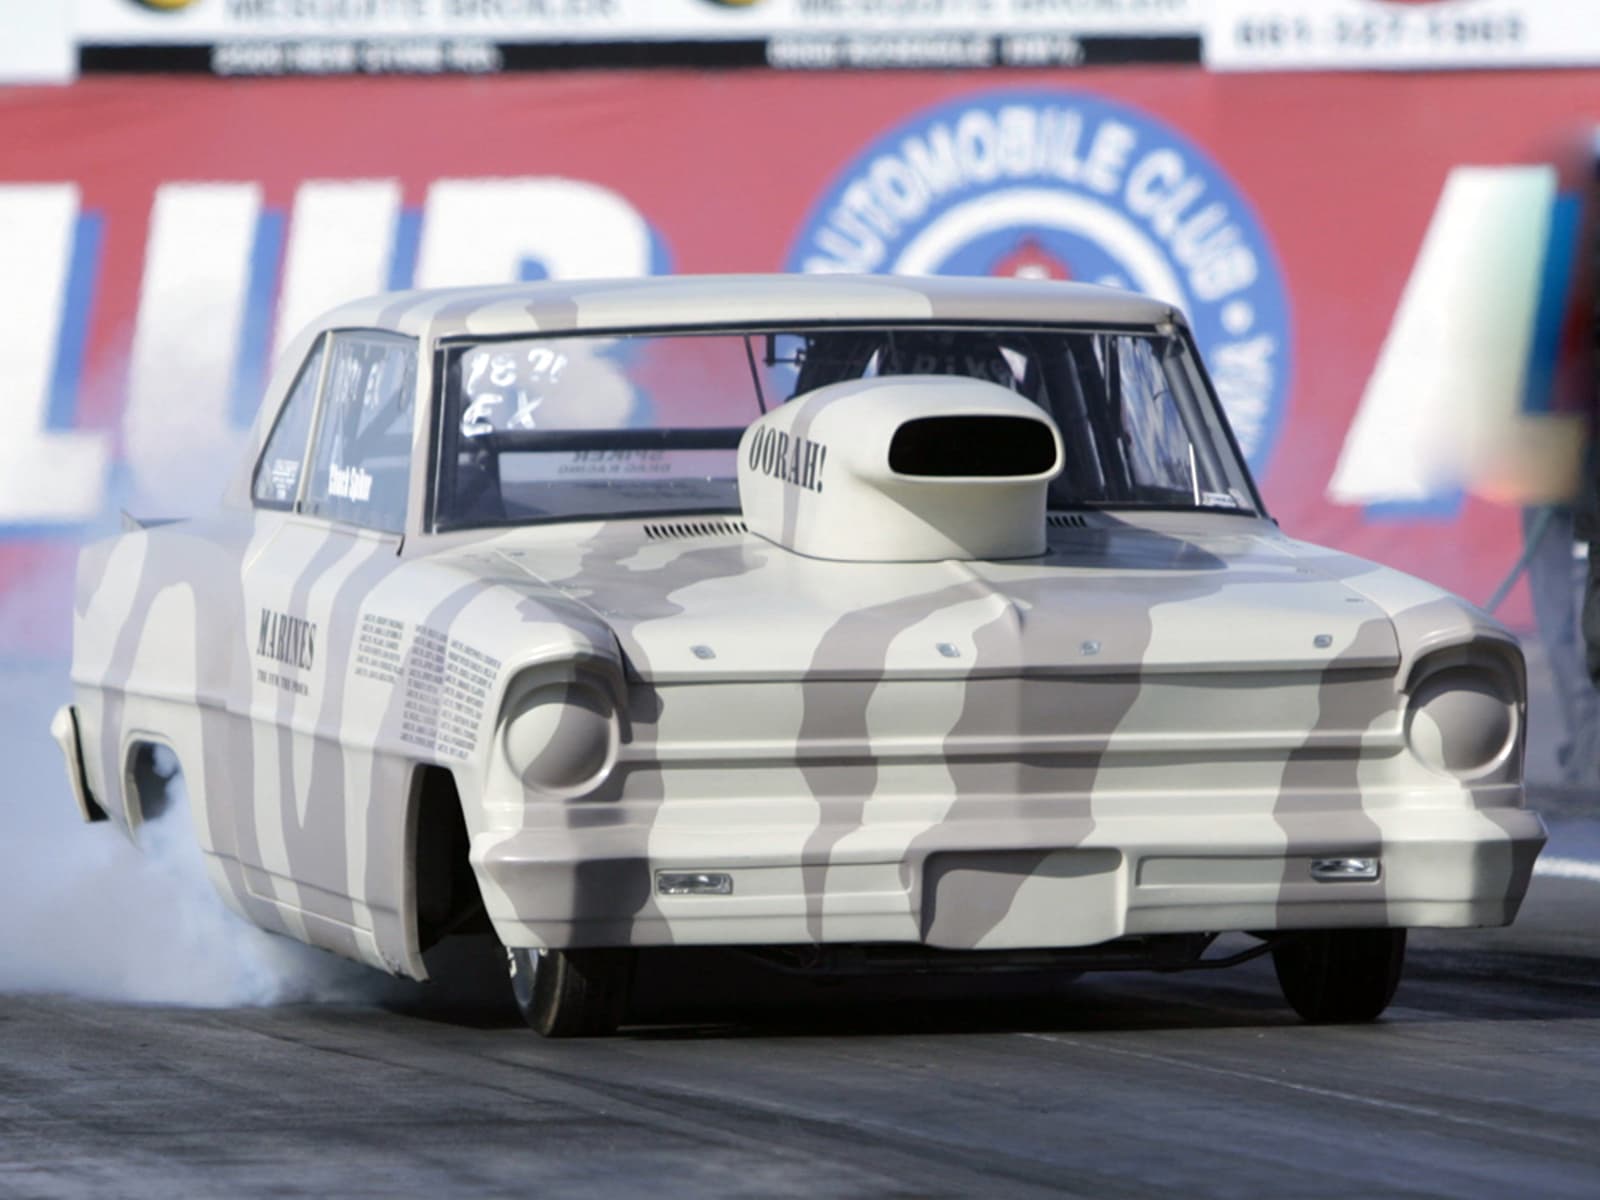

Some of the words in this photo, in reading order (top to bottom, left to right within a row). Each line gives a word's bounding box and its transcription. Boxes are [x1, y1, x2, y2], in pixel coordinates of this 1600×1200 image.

[1125, 148, 1258, 302] CLUB
[748, 423, 827, 495] OORAH!
[256, 607, 317, 672] MARINES
